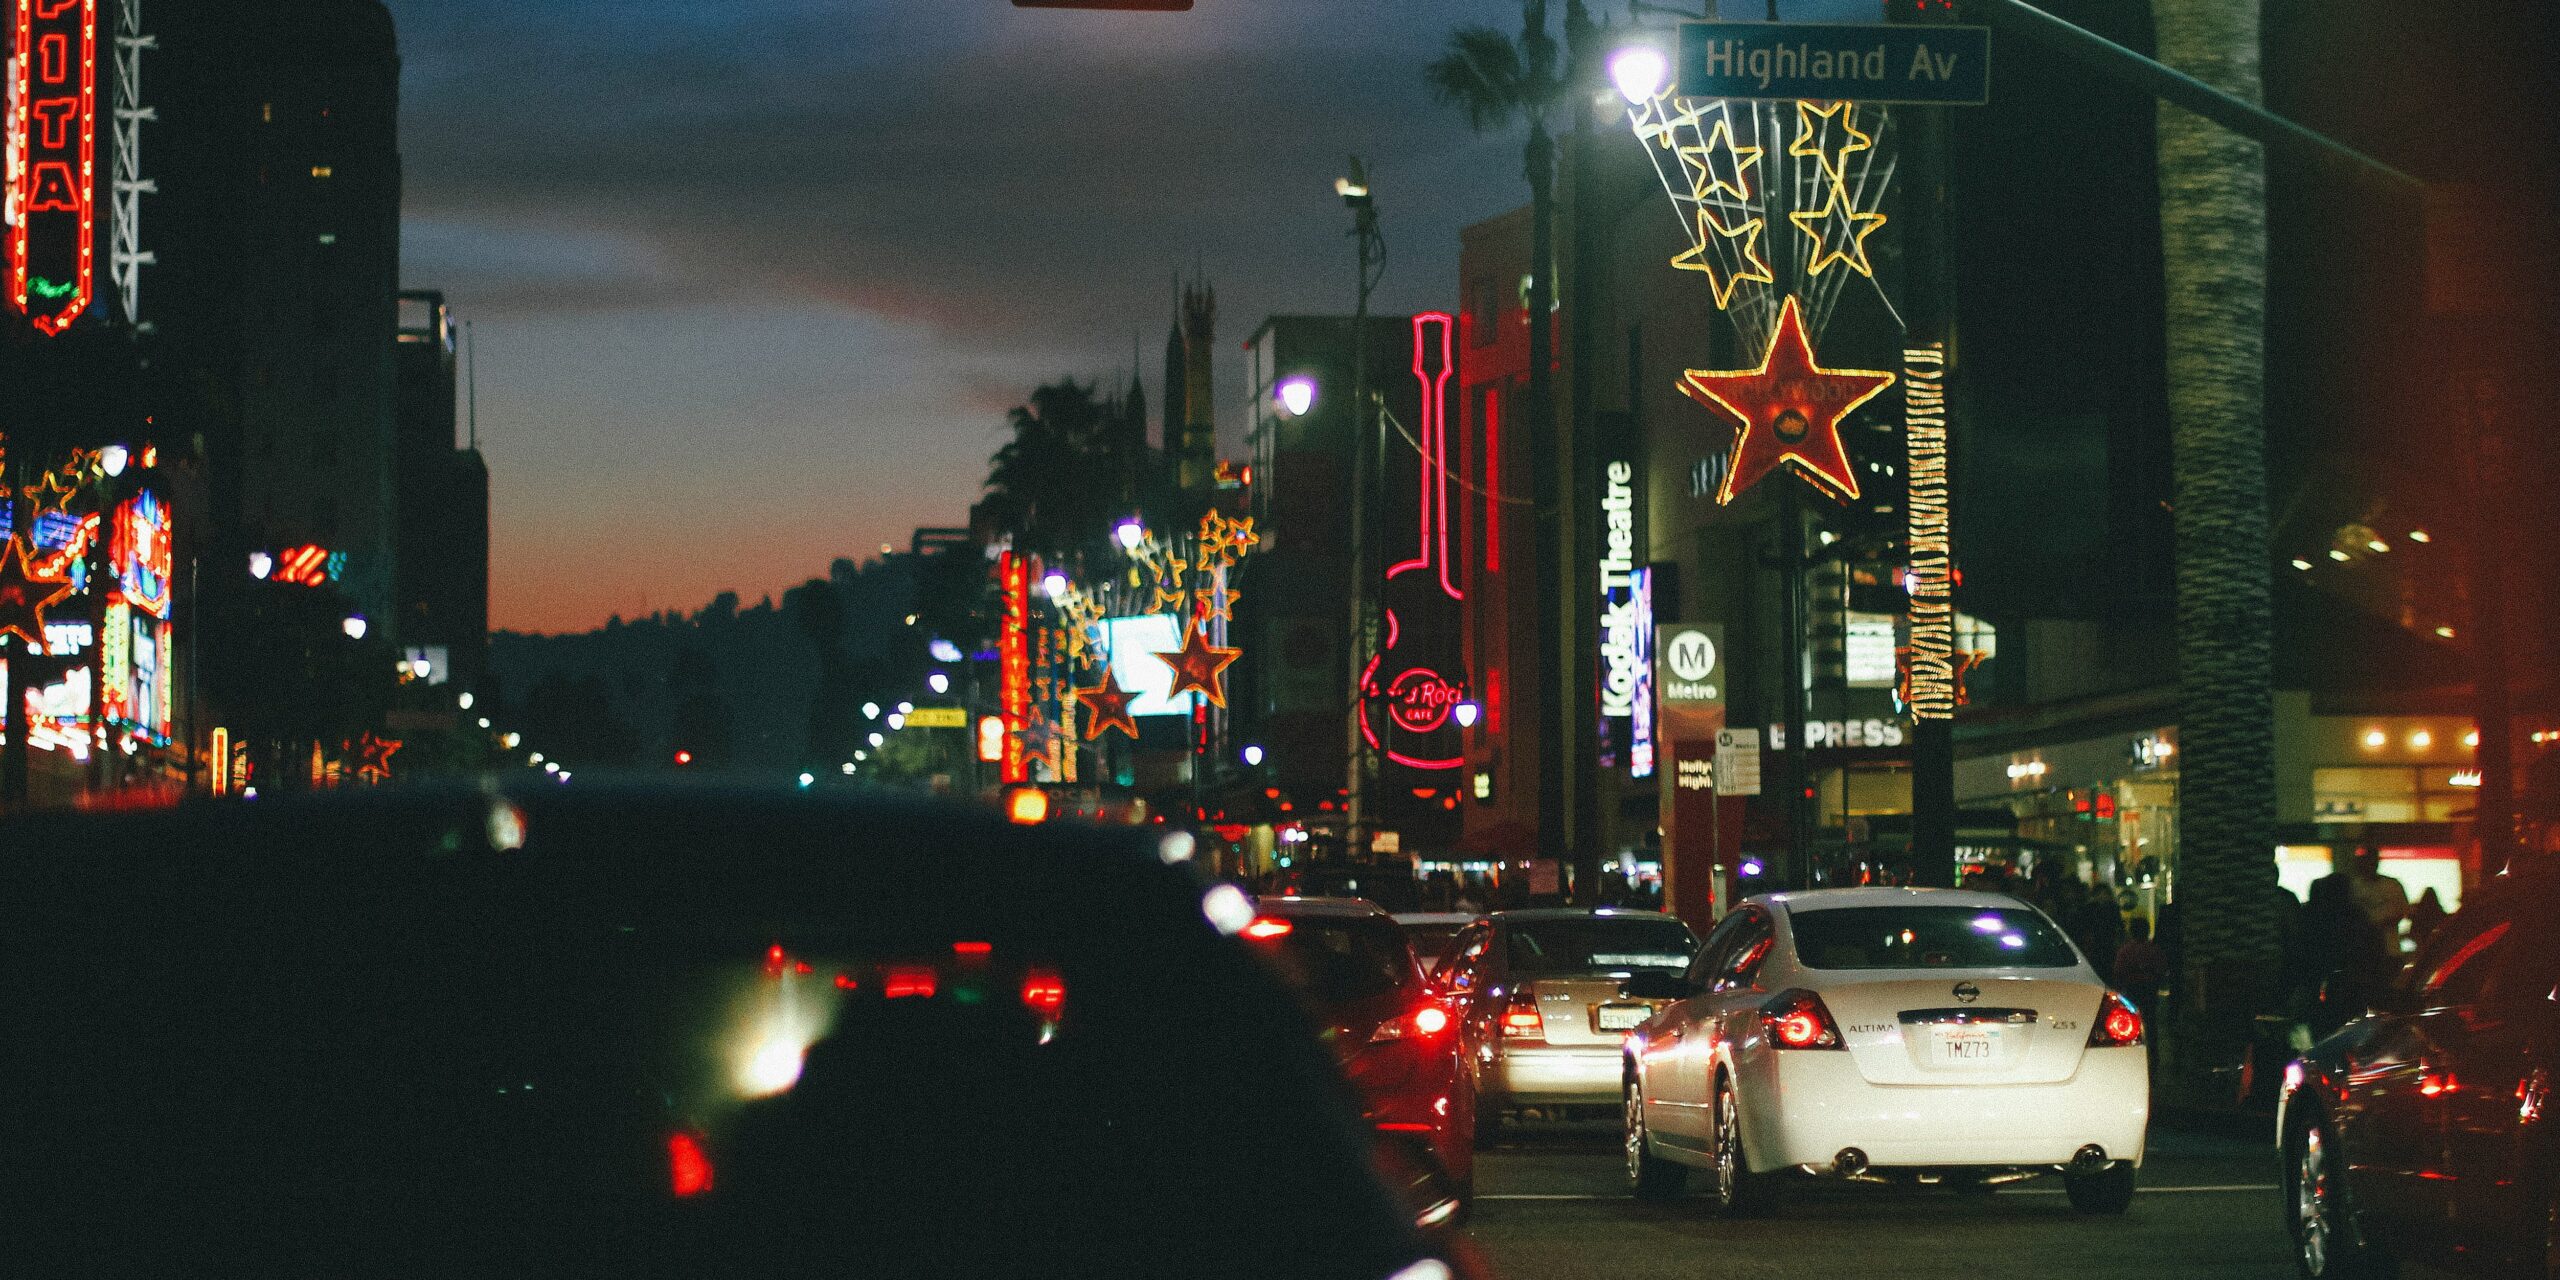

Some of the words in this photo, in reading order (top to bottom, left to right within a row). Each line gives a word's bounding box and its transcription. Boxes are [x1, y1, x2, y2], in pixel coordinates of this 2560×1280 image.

[1706, 38, 1885, 89] Highland
[1908, 43, 1957, 80] Av
[1599, 461, 1632, 595] Theatre
[1601, 600, 1633, 716] Kodak
[1679, 643, 1706, 669] M
[1667, 681, 1717, 699] Metro
[1769, 718, 1903, 750] EPRESS
[1850, 1024, 1894, 1033] ALTIMA
[1945, 1030, 1988, 1040] California
[1945, 1041, 1990, 1058] TMZ73
